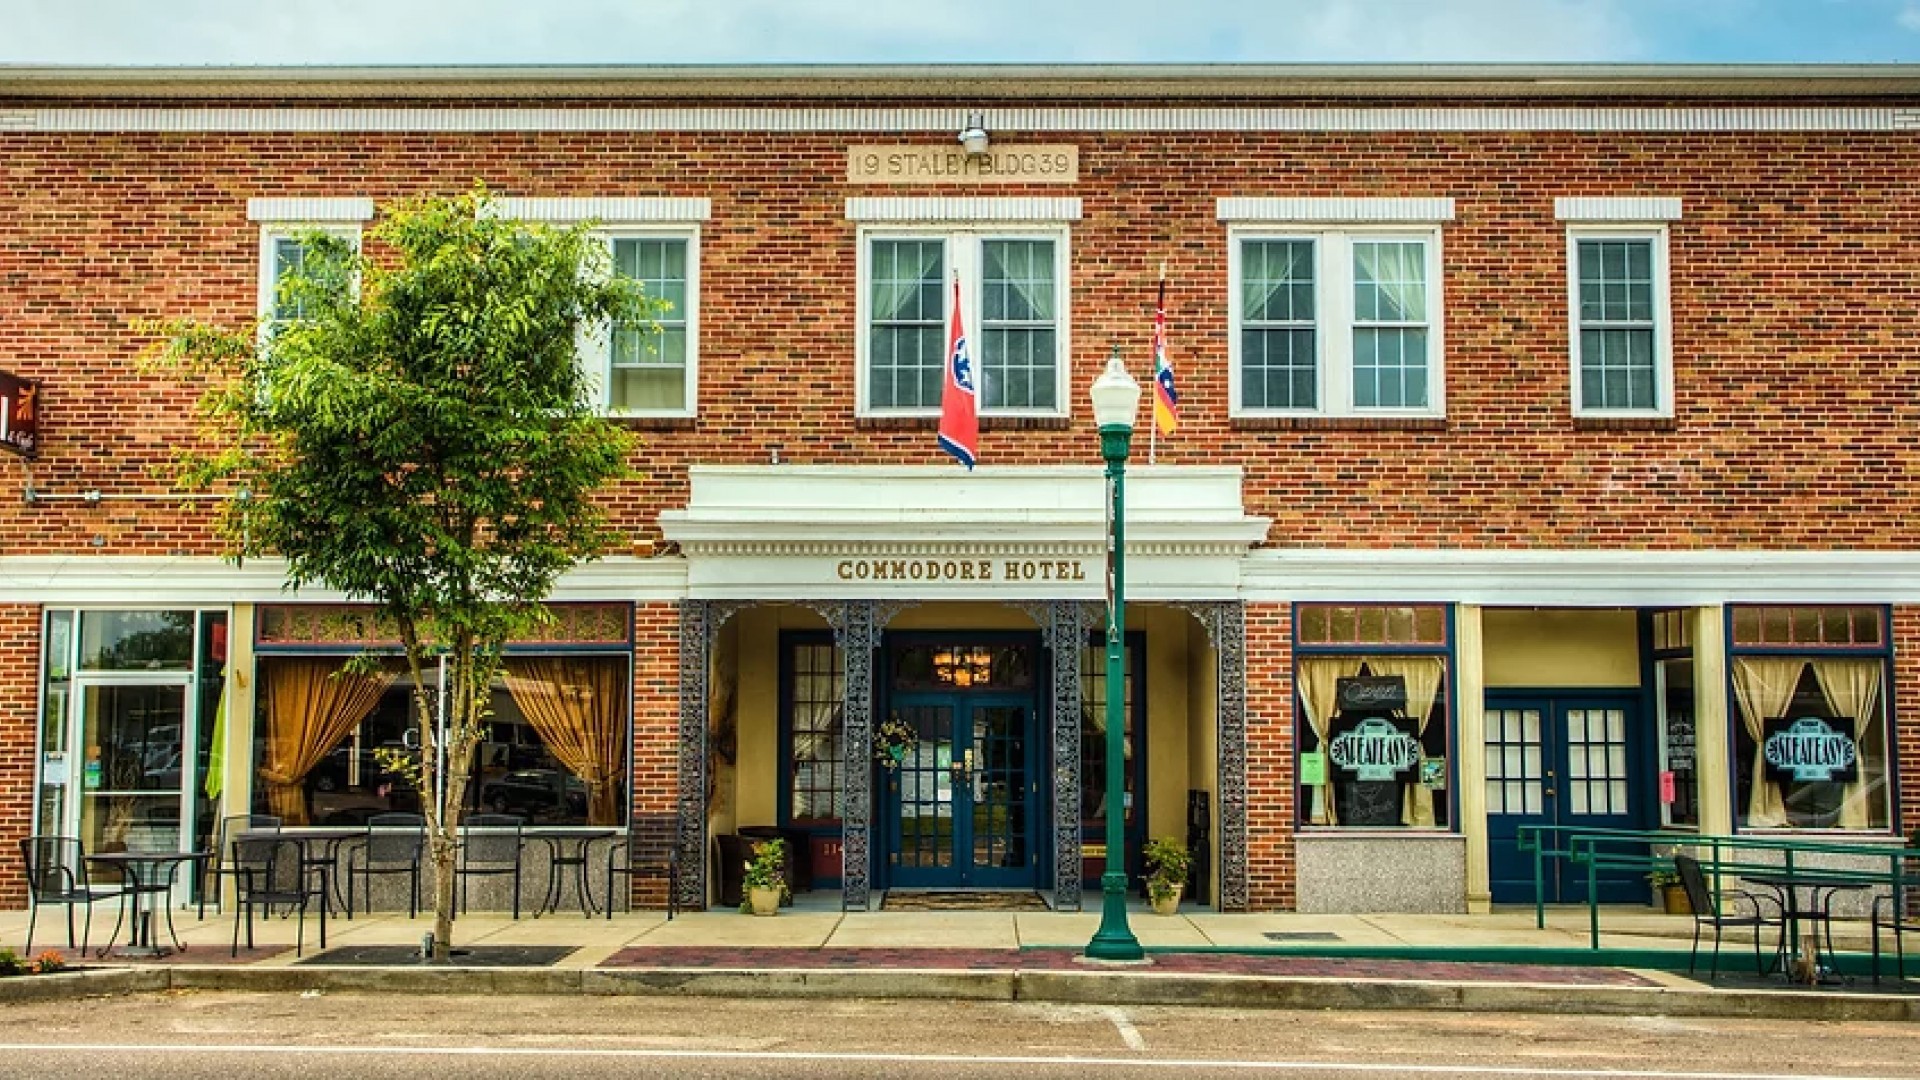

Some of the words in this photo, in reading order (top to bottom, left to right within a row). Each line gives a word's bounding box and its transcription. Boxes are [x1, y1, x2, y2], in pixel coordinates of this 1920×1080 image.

[855, 153, 880, 175] 19
[887, 153, 971, 175] STALEY
[978, 153, 1036, 175] BLDG
[1039, 153, 1069, 174] 39
[837, 560, 992, 580] COMMODORE
[1004, 560, 1085, 580] HOTEL
